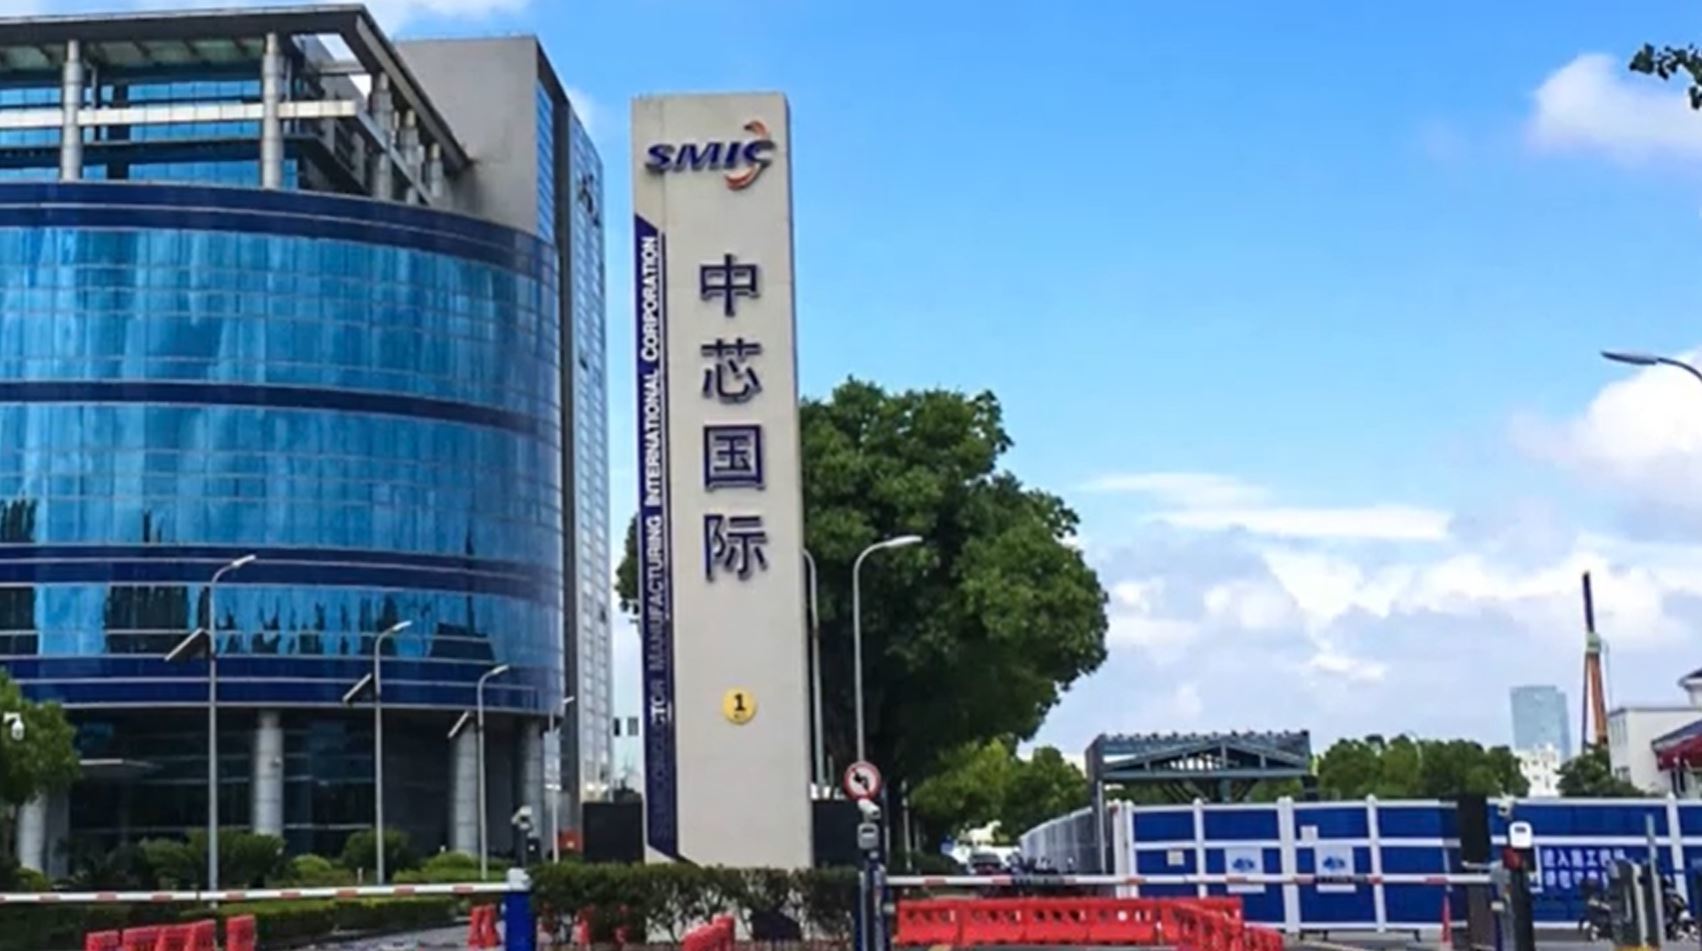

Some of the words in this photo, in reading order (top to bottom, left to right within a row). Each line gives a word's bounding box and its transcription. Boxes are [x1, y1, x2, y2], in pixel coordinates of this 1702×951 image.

[645, 138, 777, 175] SMIC
[641, 236, 659, 362] CORPORATION
[643, 368, 662, 507] INTERNATIONAL
[700, 253, 768, 583] 中芯国际
[646, 515, 665, 671] MANUFACTURING
[734, 693, 747, 711] 1
